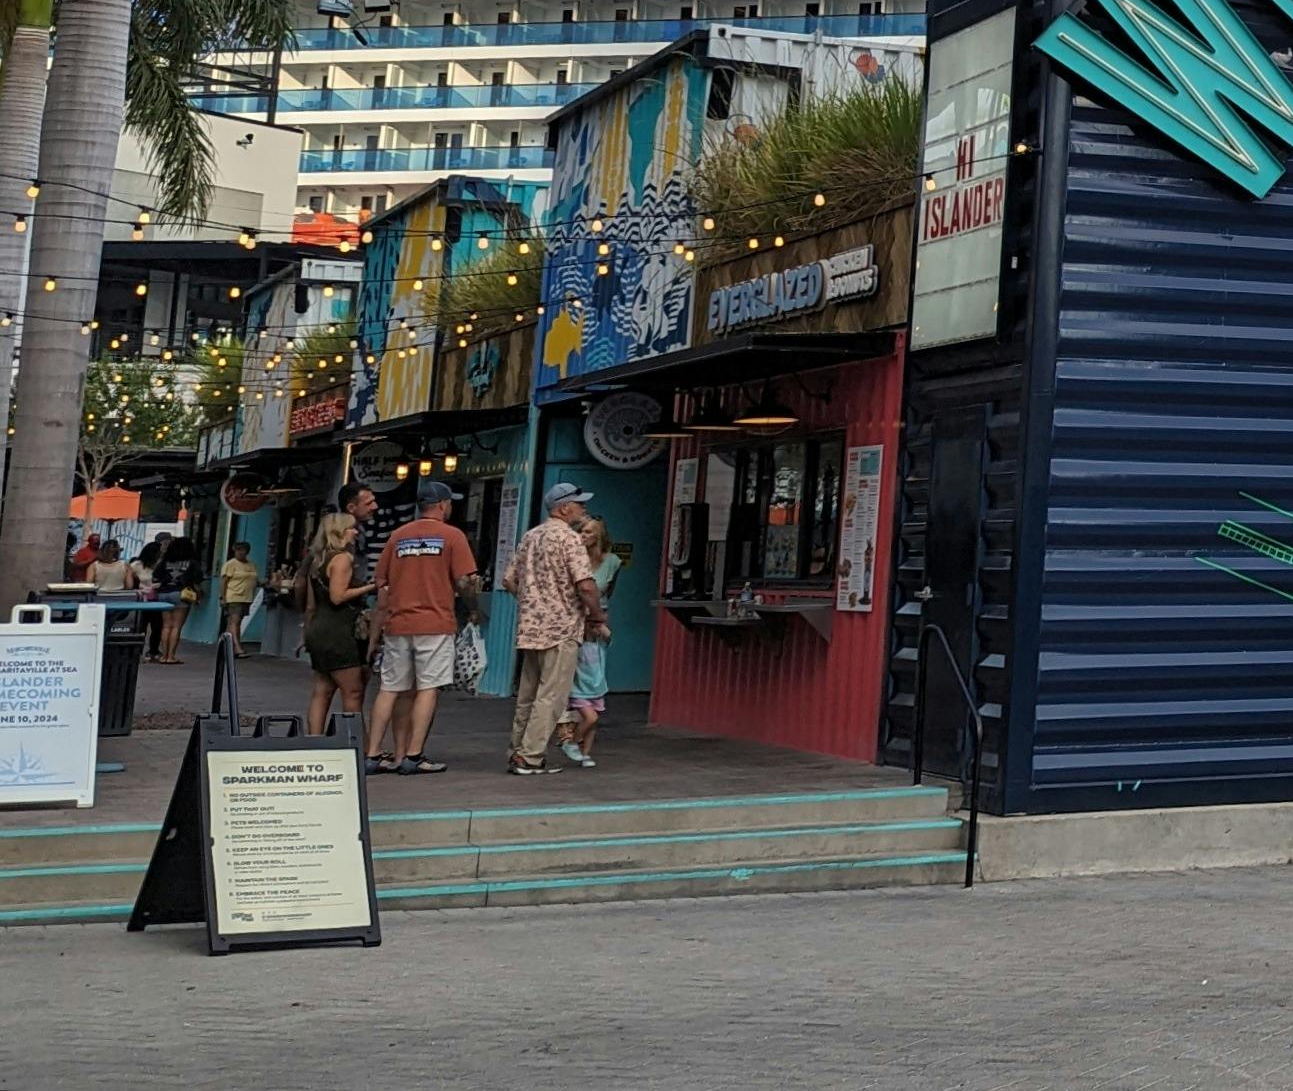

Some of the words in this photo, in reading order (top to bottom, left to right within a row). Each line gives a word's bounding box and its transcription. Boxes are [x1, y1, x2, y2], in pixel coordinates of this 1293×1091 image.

[956, 135, 975, 181] HI
[923, 177, 1003, 240] ISLANDER
[708, 262, 823, 330] EVERGLAZED
[398, 547, 440, 557] patagonia
[0, 677, 64, 687] LANDER
[1, 701, 48, 712] EVENT
[18, 715, 32, 724] 10,
[33, 715, 58, 723] 2024
[241, 765, 305, 774] WELCOME
[306, 764, 324, 772] TO
[222, 775, 294, 785] SPARKMAN
[296, 774, 344, 783] WHARF
